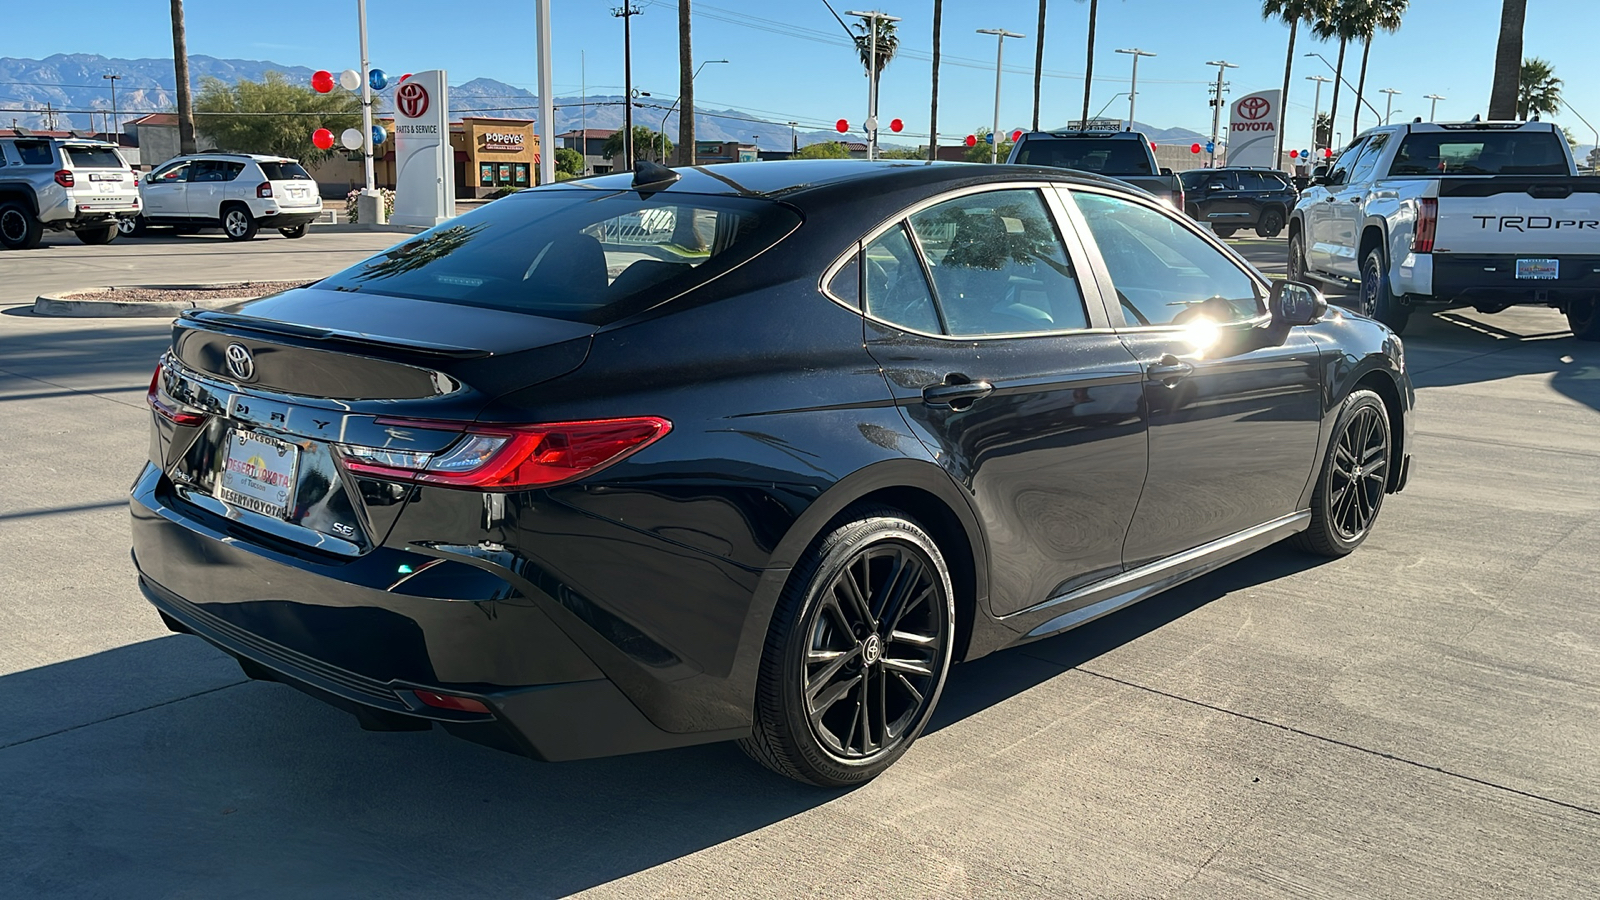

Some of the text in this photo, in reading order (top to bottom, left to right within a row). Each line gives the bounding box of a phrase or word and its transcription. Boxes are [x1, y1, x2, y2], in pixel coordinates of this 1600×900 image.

[396, 124, 437, 133] PARTS & SERVICE
[1231, 122, 1274, 132] TOYOTA
[485, 132, 525, 144] POPEYES
[1472, 216, 1552, 233] TRD
[244, 431, 279, 447] TUCSON
[227, 457, 289, 488] DESERT TOYOTA
[240, 478, 266, 492] of Tucson
[220, 488, 282, 519] DESERT TOYOTA
[332, 522, 354, 537] SE
